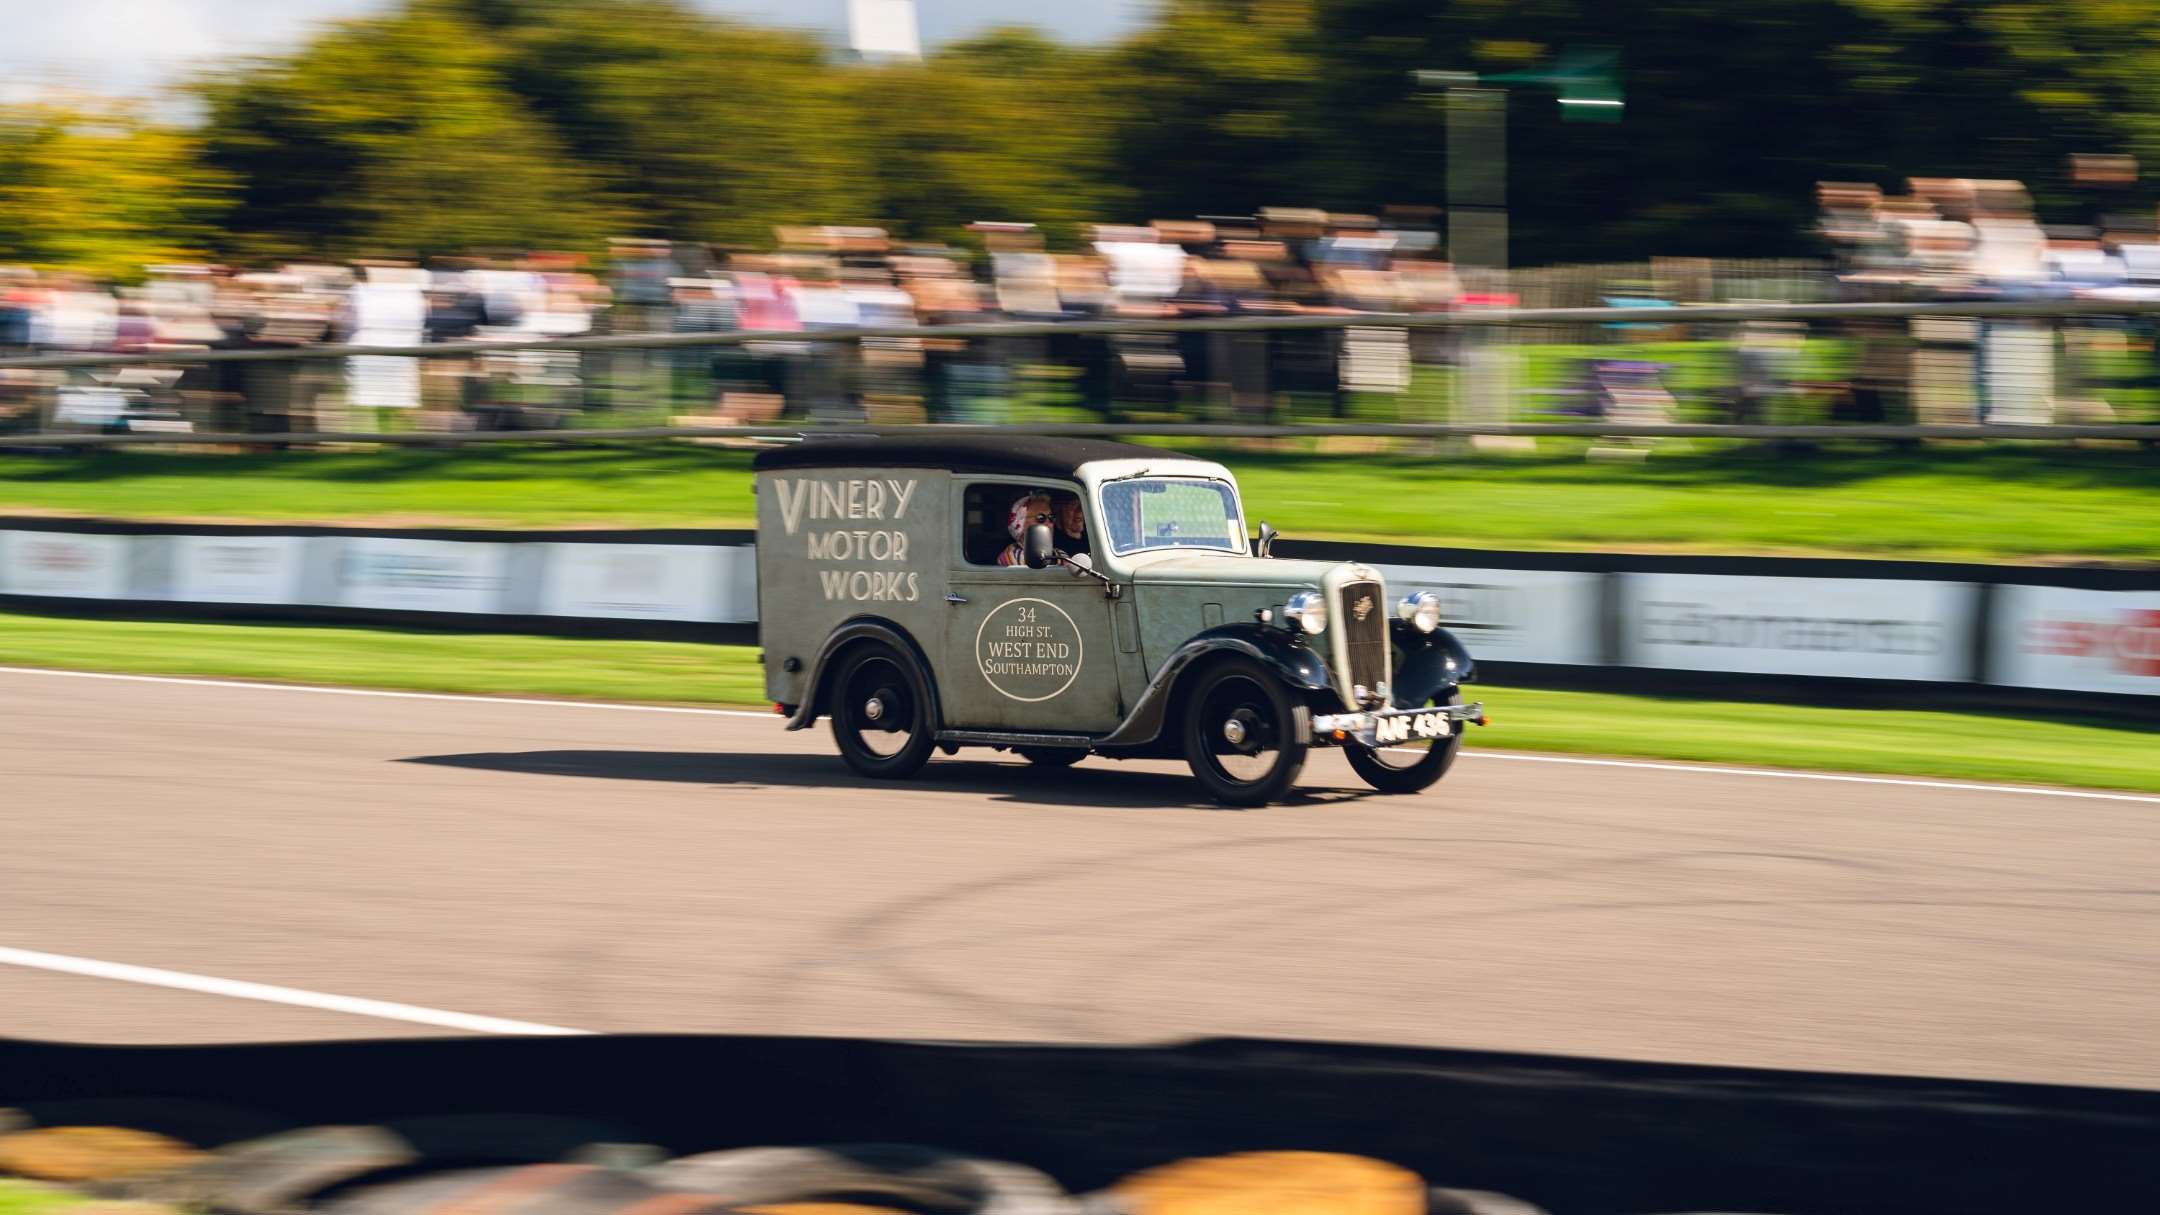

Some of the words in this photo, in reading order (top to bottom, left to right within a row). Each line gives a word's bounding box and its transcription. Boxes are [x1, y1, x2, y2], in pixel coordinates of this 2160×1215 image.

[774, 479, 918, 536] VINERY
[808, 530, 909, 561] MOTOR
[820, 571, 920, 601] WORKS
[1017, 607, 1036, 623] 34
[1006, 625, 1033, 637] HIGH
[1036, 626, 1053, 638] ST.
[988, 641, 1032, 658] WEST
[1036, 643, 1069, 659] END
[985, 658, 1073, 676] SOUTHAMPTON
